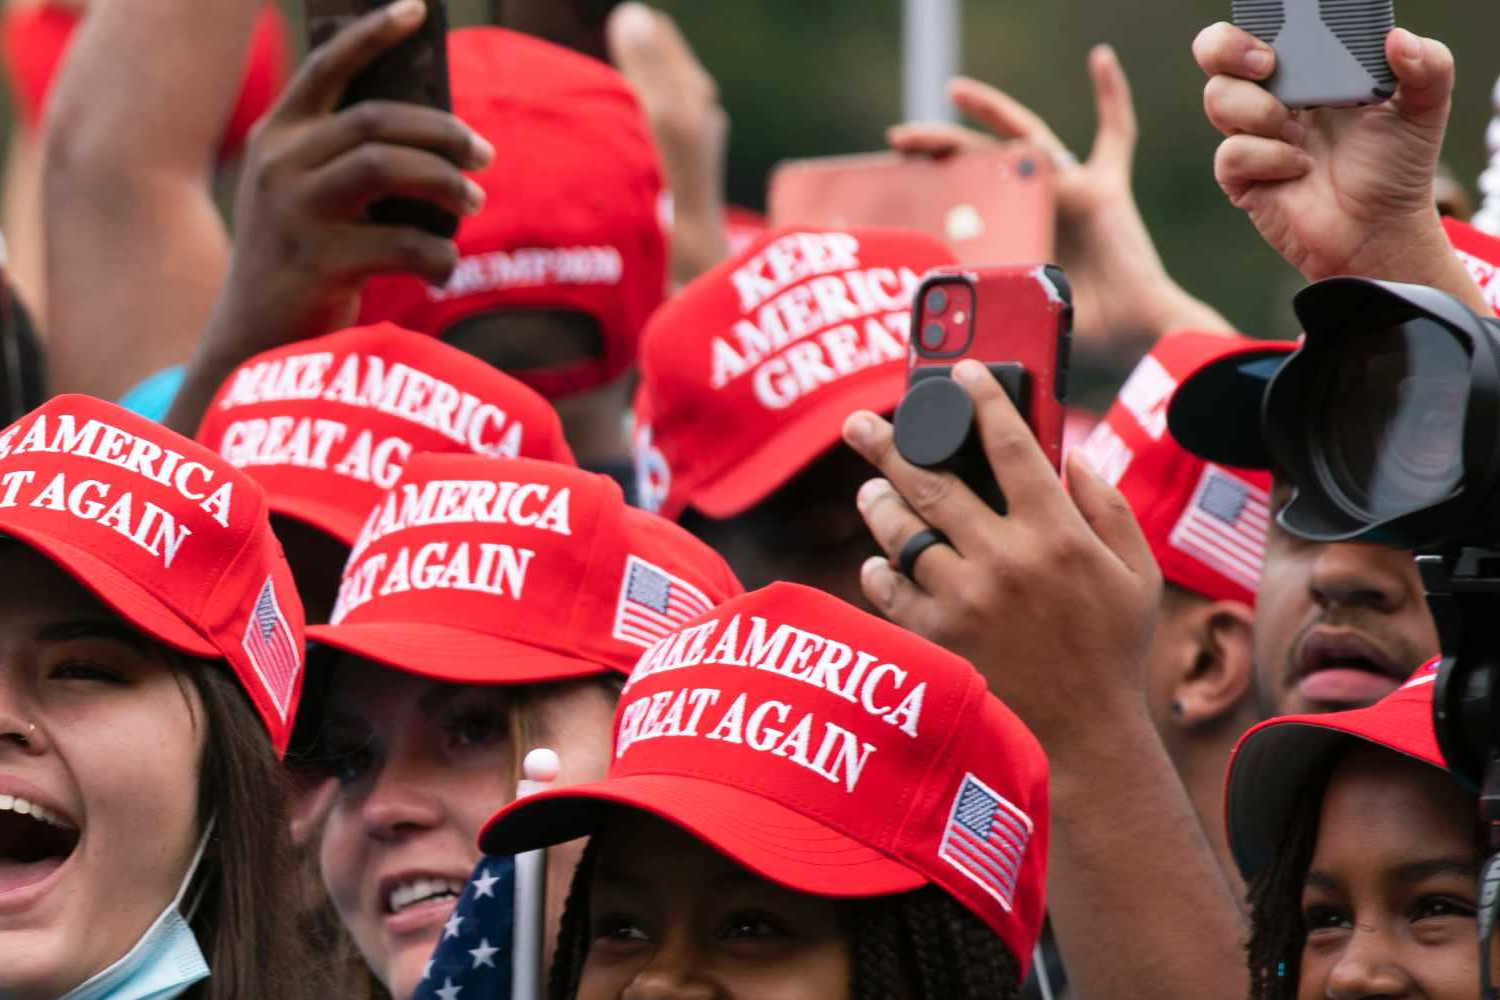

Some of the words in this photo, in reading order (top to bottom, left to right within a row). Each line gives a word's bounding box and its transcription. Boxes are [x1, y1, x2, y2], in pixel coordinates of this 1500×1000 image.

[732, 231, 860, 312] KEEP
[219, 352, 333, 410] MAKE
[331, 353, 523, 458] AMERICA
[220, 415, 348, 469] GREAT
[12, 414, 234, 529] AMERICA
[370, 480, 572, 542] AMERICA
[29, 472, 192, 569] AGAIN
[378, 540, 535, 601] AGAIN
[621, 618, 720, 695] MAKE
[702, 613, 927, 739] AMERICA
[615, 687, 722, 759] GREAT
[705, 692, 877, 793] AGAIN
